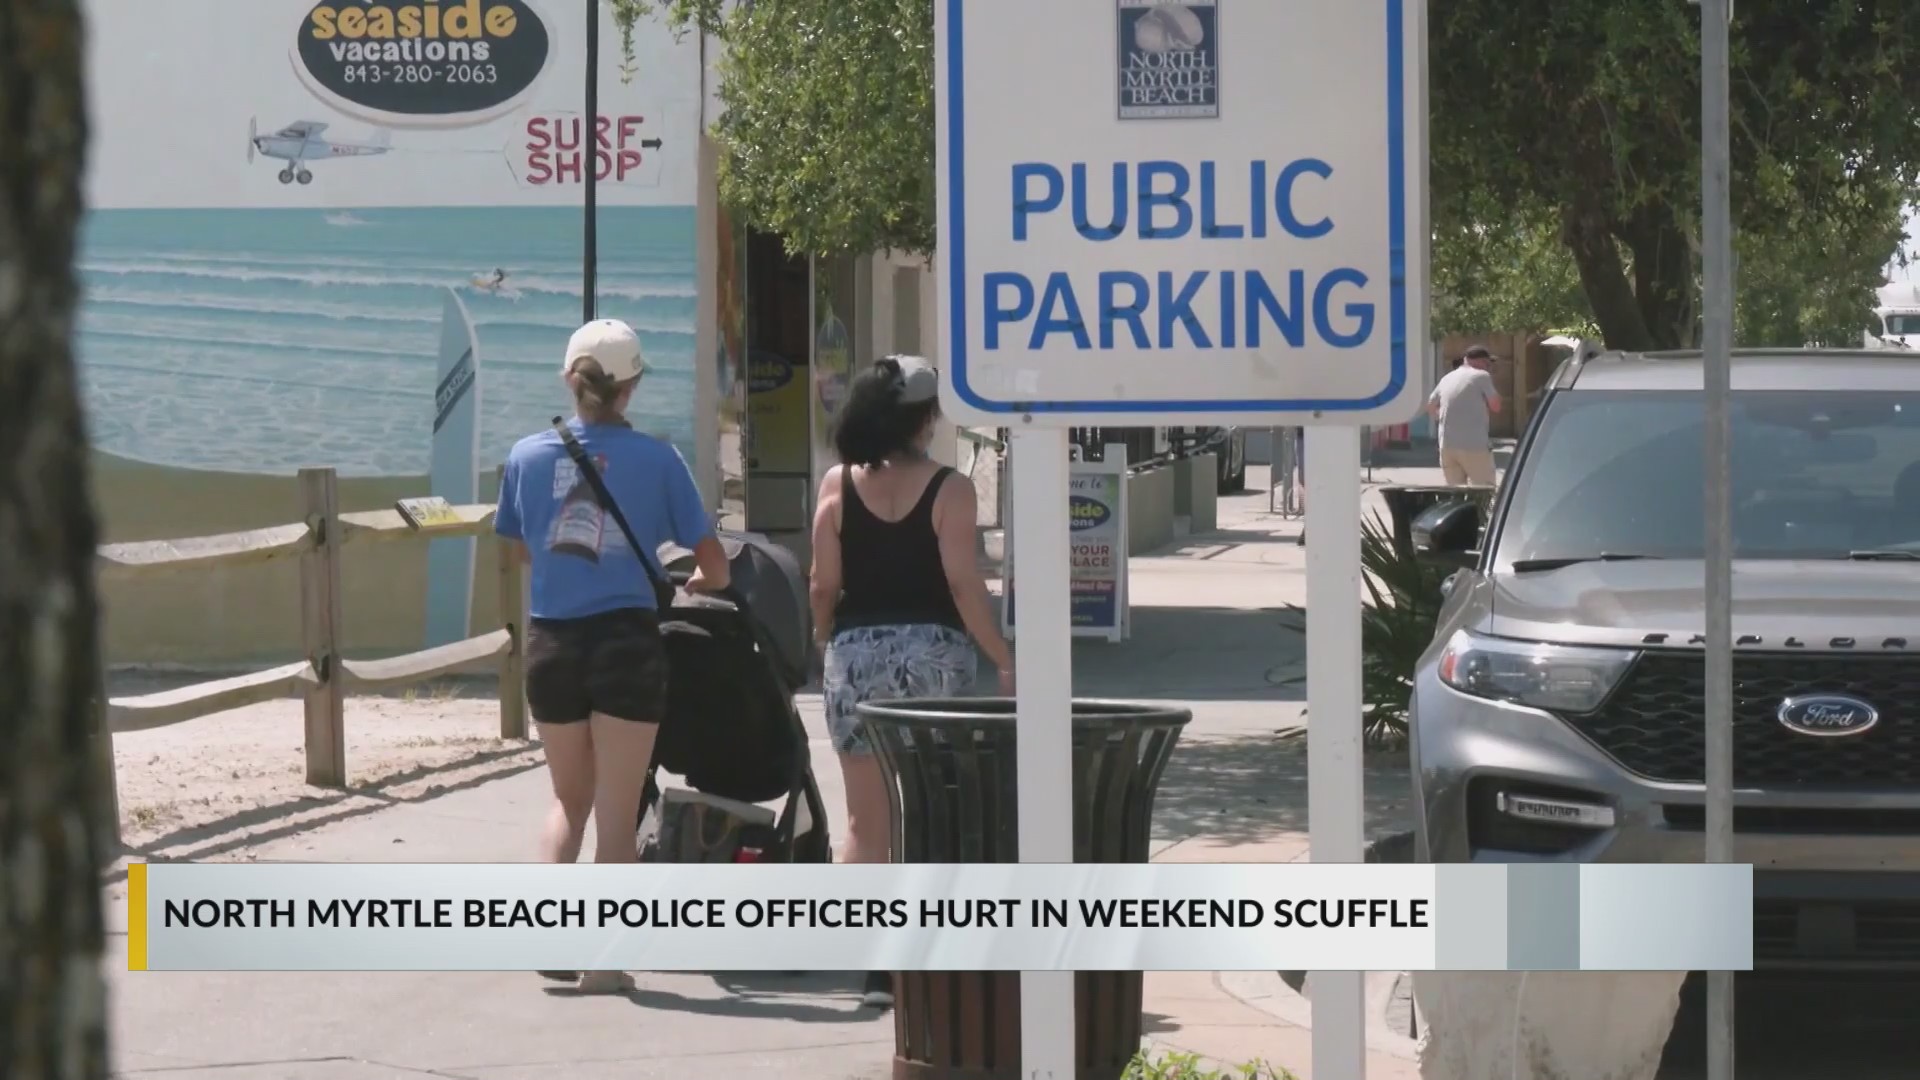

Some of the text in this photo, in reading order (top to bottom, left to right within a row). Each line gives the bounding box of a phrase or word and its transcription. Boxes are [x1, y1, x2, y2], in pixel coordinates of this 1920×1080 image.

[311, 0, 517, 38] seaside
[329, 38, 490, 62] vacations
[1129, 51, 1206, 70] NORTH
[344, 65, 498, 83] 843-280-2063
[1126, 71, 1212, 88] MYRTLE
[1131, 88, 1205, 104] BEACH
[526, 116, 644, 151] SURF
[526, 150, 642, 185] SHOP
[1011, 158, 1335, 242] PUBLIC
[983, 267, 1376, 350] PARKING
[1071, 545, 1110, 556] YOUR
[1802, 703, 1854, 726] Ford
